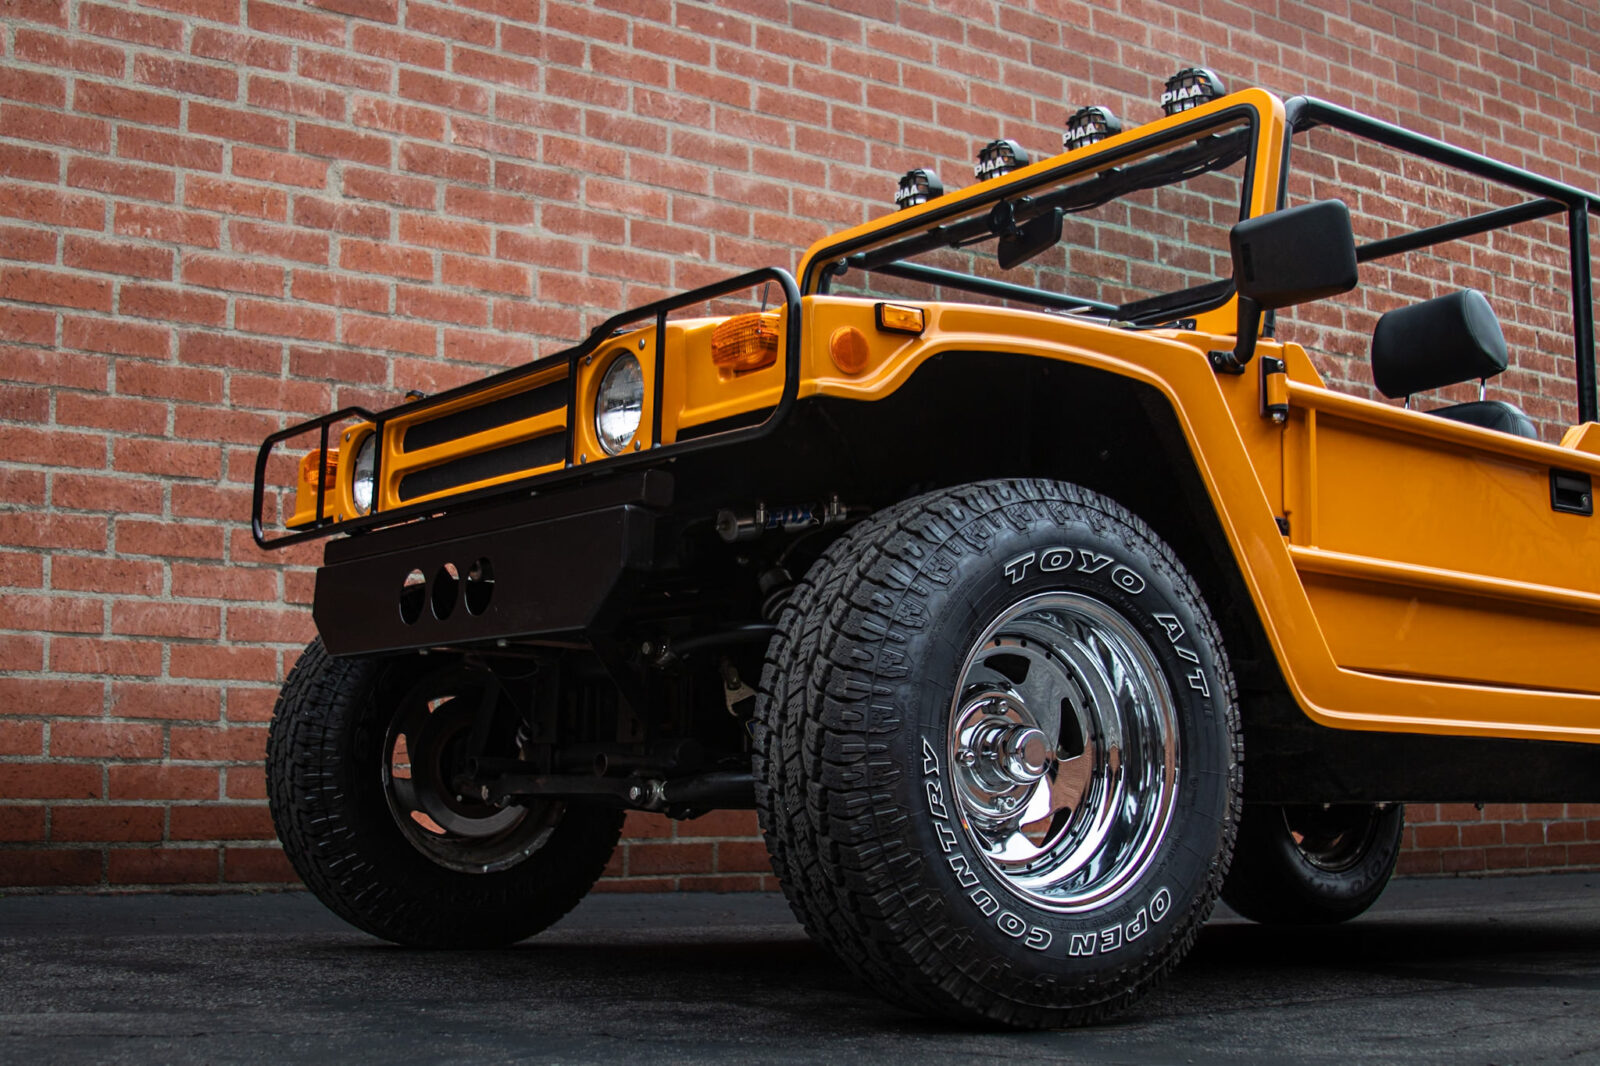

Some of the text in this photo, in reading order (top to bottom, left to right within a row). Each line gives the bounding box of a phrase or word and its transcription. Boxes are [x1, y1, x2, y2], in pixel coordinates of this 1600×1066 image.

[1161, 83, 1202, 106] PIAA
[1062, 122, 1096, 144] PIAA
[974, 156, 1006, 177] PIAA
[894, 184, 919, 202] PIAA
[1005, 547, 1146, 595] TOYO
[1153, 613, 1210, 698] A/T
[921, 735, 1172, 957] OPEN COUNTRY
